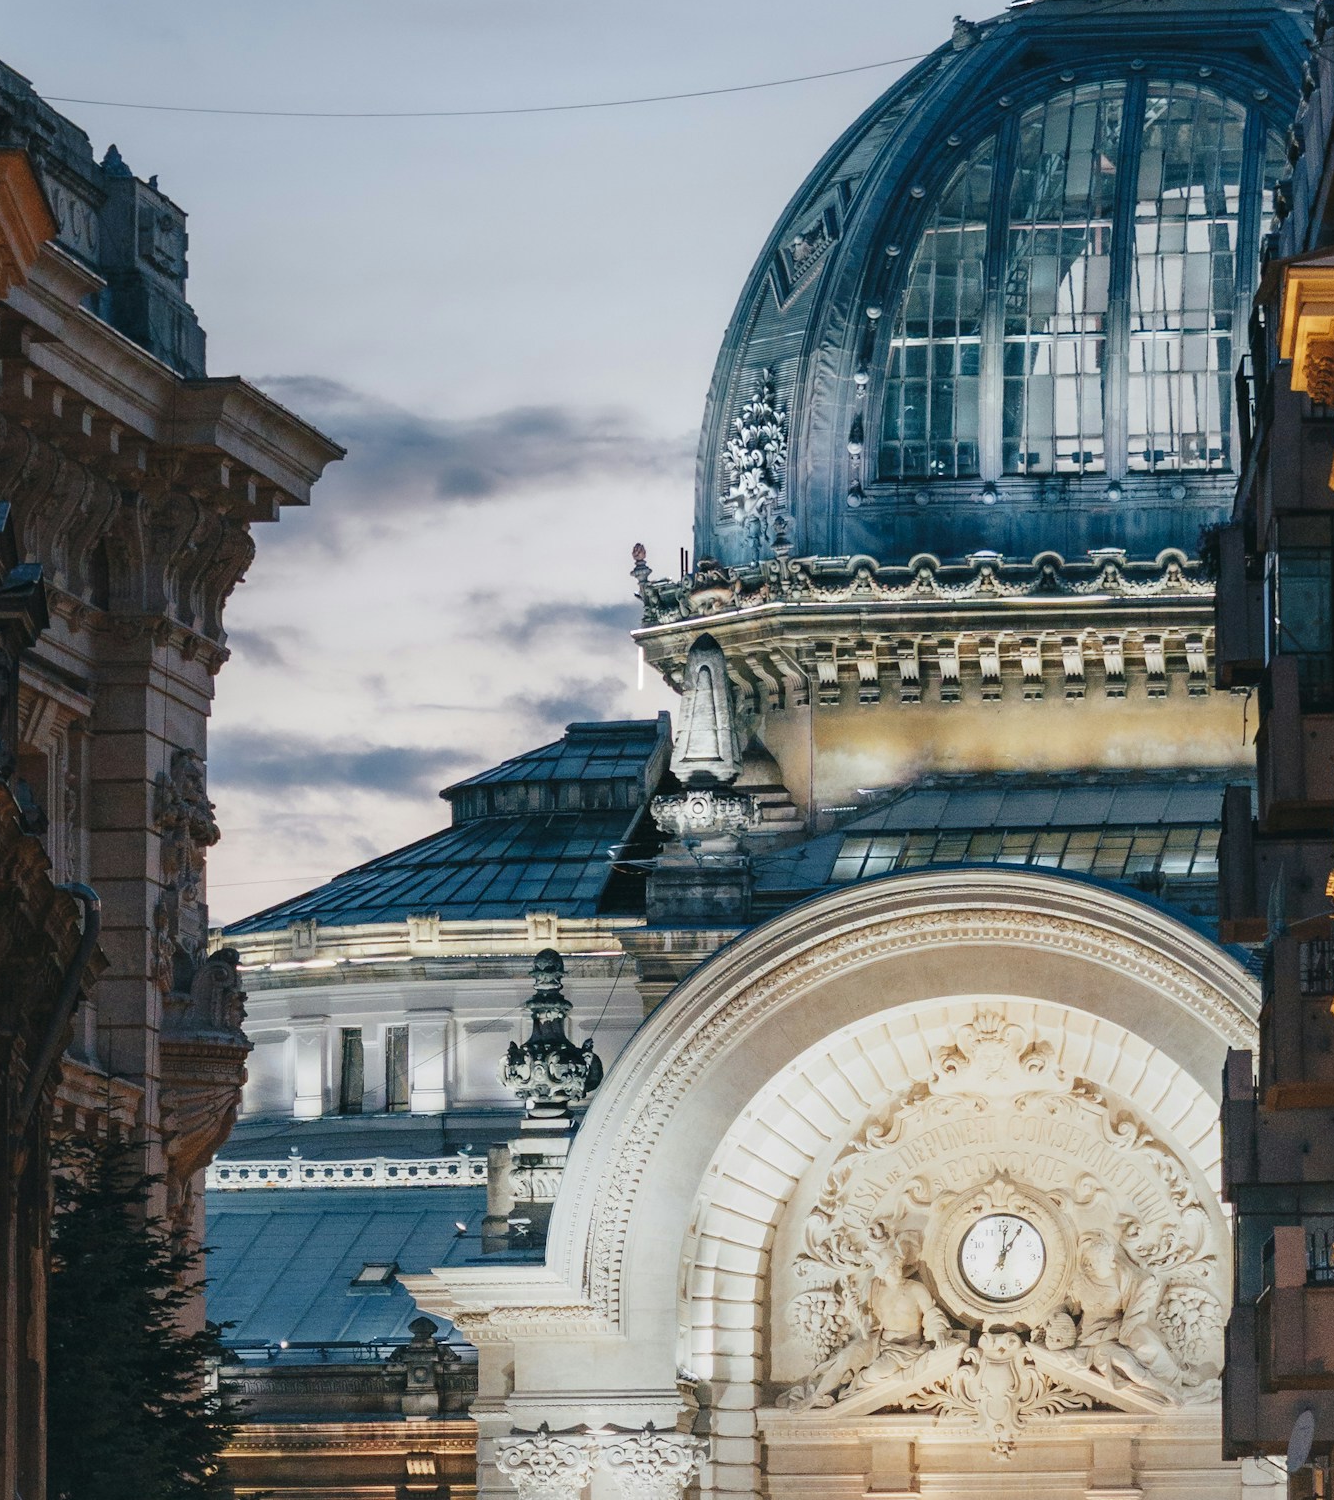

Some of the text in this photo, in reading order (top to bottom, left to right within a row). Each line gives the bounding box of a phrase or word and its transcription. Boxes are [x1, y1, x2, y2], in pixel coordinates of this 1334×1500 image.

[841, 1177, 889, 1230] CASA
[897, 1115, 999, 1171] DEPUNERI
[941, 1150, 1068, 1183] ECONOMIE
[974, 1241, 985, 1249] 10
[999, 1283, 1007, 1291] 6
